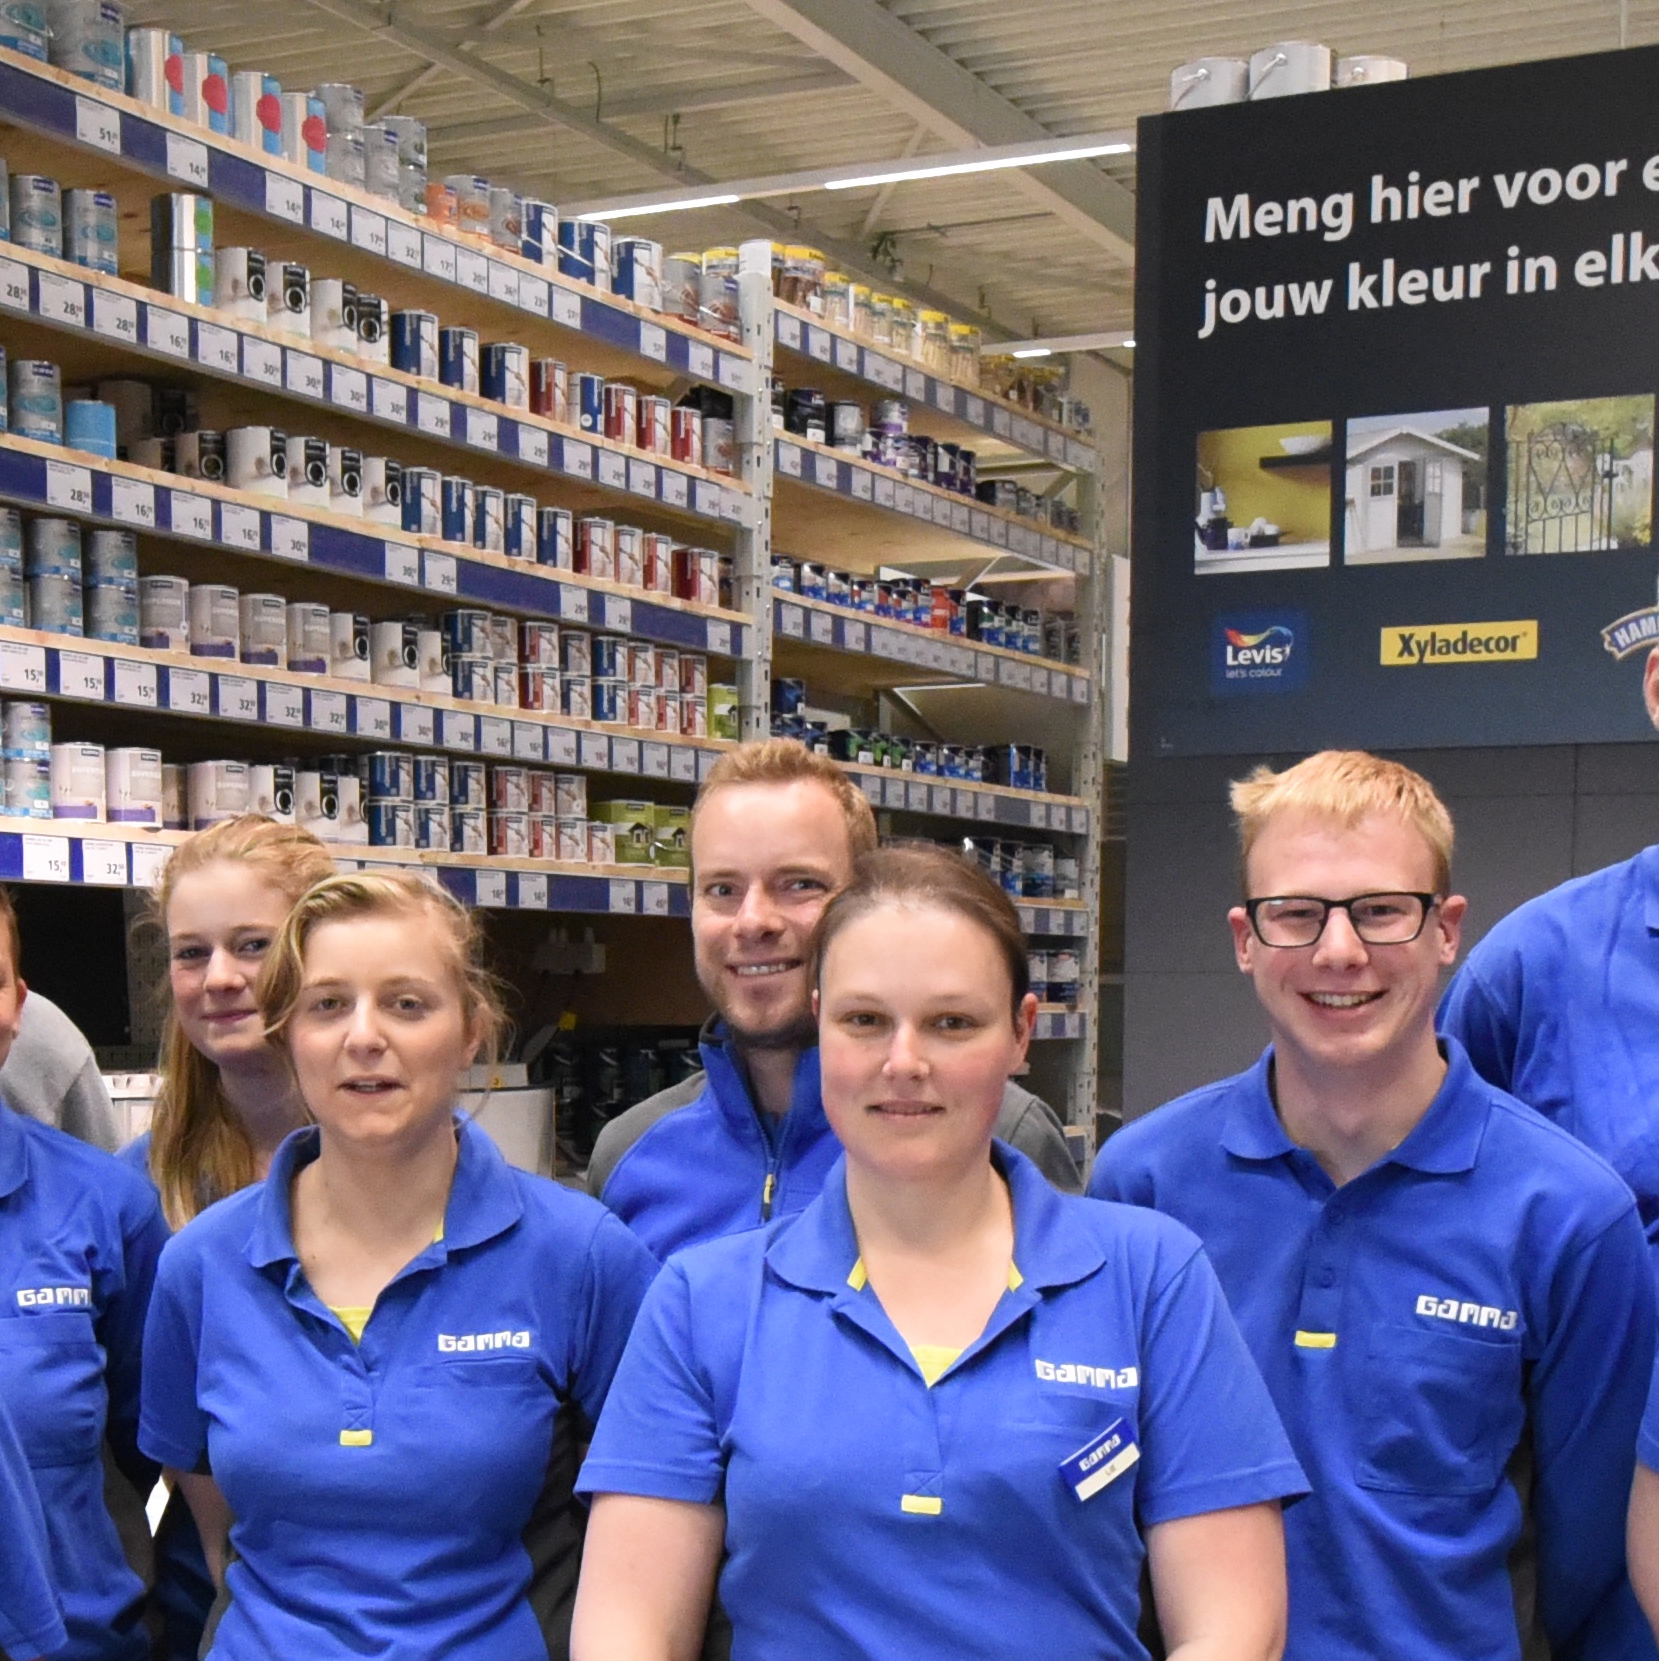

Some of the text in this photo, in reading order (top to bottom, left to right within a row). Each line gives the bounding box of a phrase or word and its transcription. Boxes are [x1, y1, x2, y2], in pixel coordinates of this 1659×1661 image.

[1204, 192, 1354, 244] Meng
[1370, 170, 1480, 226] hier
[1494, 158, 1628, 209] voor
[1197, 279, 1333, 339] jouw
[1348, 256, 1491, 311] kleur
[1506, 246, 1557, 295] in
[1226, 645, 1283, 666] Levis
[1397, 630, 1521, 664] Xyladecor
